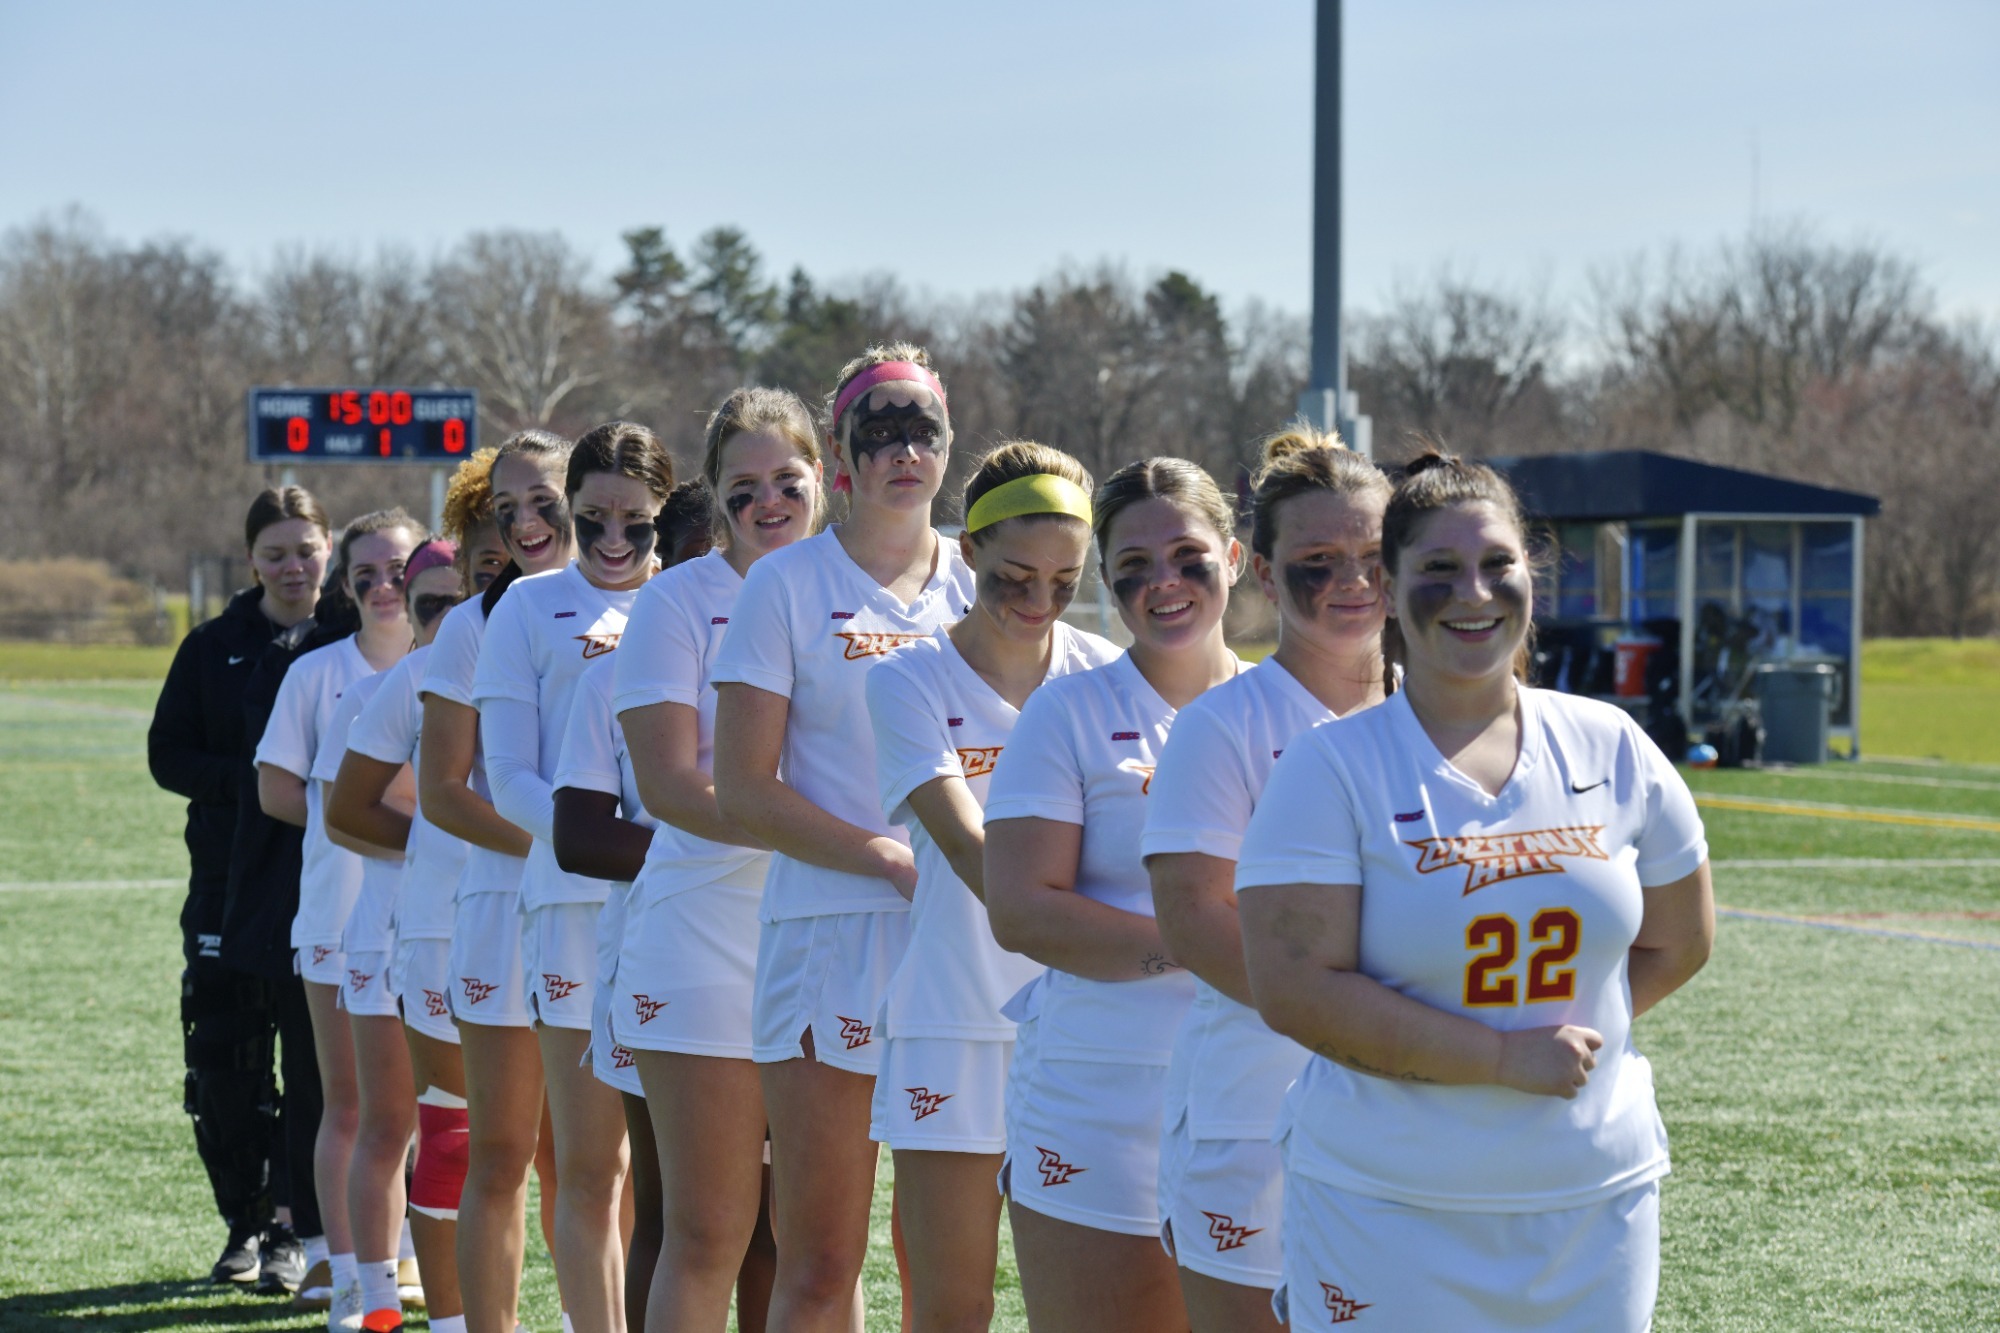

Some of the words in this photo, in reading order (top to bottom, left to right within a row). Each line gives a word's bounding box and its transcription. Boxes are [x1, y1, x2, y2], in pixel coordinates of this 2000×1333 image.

[287, 417, 309, 452] 0
[379, 428, 391, 457] 1
[443, 418, 466, 453] 0
[1410, 826, 1608, 873] CHESTNUT
[1464, 853, 1566, 893] HILL
[1462, 906, 1582, 1007] 22
